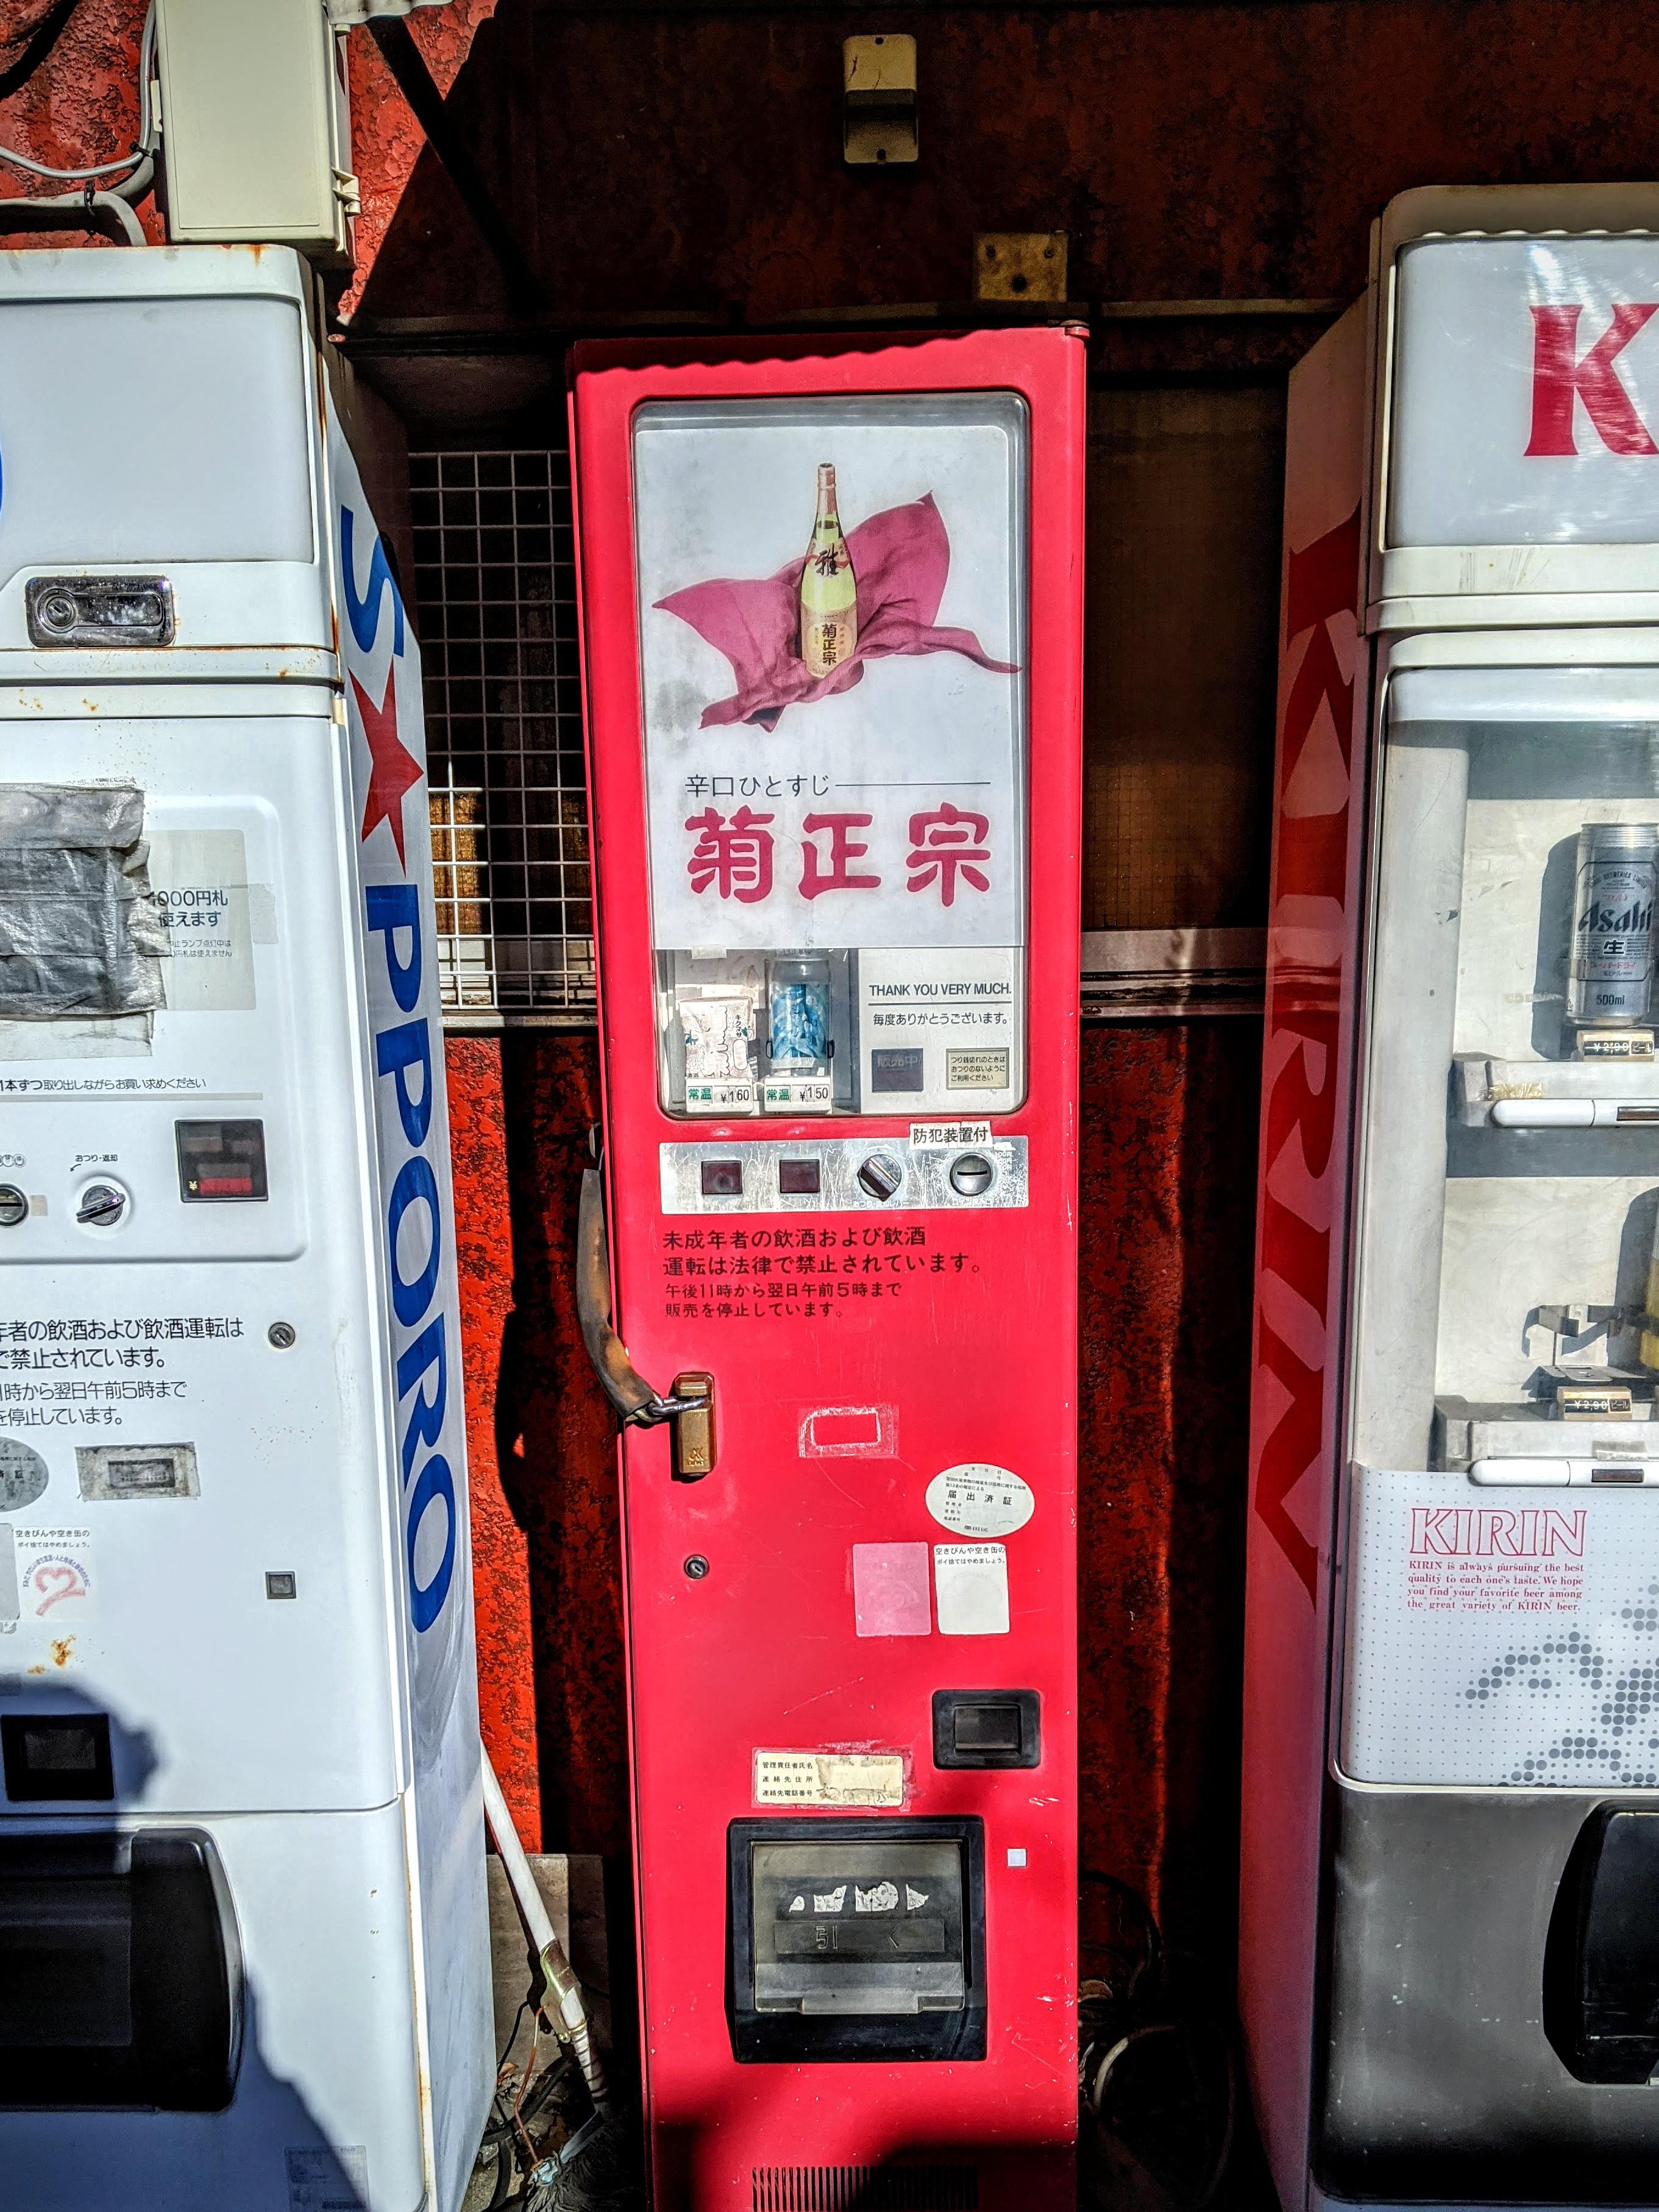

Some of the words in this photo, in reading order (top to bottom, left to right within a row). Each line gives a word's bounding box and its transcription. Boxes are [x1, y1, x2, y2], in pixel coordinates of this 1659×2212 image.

[822, 623, 837, 666] 菊正宗
[685, 774, 830, 798] 辛口ひとすじ
[685, 803, 991, 907] 菊正宗
[158, 910, 221, 927] 使えます
[1579, 899, 1653, 932] Asahi
[1603, 939, 1625, 955] 生
[869, 985, 911, 996] THANK
[914, 984, 938, 995] YOU
[941, 984, 971, 994] VERY
[974, 983, 1012, 994] MUCH.
[1596, 994, 1625, 1005] 500ml
[873, 1012, 1007, 1026] 毎度ありがとうございます。
[1254, 497, 1362, 1615] KIRIN
[0, 1078, 206, 1091] 1本ずつ取り出しながらお買い求めください
[688, 1088, 712, 1101] 常温
[721, 1089, 750, 1103] ¥160
[766, 1089, 790, 1101] 常温
[800, 1087, 829, 1102] ¥150
[913, 1127, 989, 1144] 防犯装置付
[663, 1225, 926, 1250] 未成年者の飲酒および飲酒
[663, 1252, 980, 1277] 運転は法律で禁止されています。
[665, 1281, 902, 1299] 午後11時から翌日午前5時まで
[665, 1302, 843, 1319] 販売を停止しています。
[1611, 1401, 1629, 1409] ビール
[948, 1489, 1012, 1506] 届出済証
[1410, 1508, 1588, 1557] KIRIN
[936, 1547, 1005, 1555] 空きびんや空き缶の
[1409, 1561, 1443, 1569] KIRIN
[1459, 1562, 1493, 1572] always
[1497, 1564, 1540, 1572] pursuing
[1408, 1573, 1441, 1584] quality
[1486, 1576, 1510, 1584] one's
[1561, 1578, 1583, 1587] hope
[1429, 1587, 1449, 1596] find
[1480, 1589, 1519, 1598] favorite
[1524, 1589, 1544, 1598] beer
[1407, 1600, 1423, 1608] the
[1429, 1601, 1455, 1609] great
[1463, 1602, 1496, 1611] variety
[1502, 1601, 1512, 1610] of
[1557, 1602, 1580, 1611] beer.
